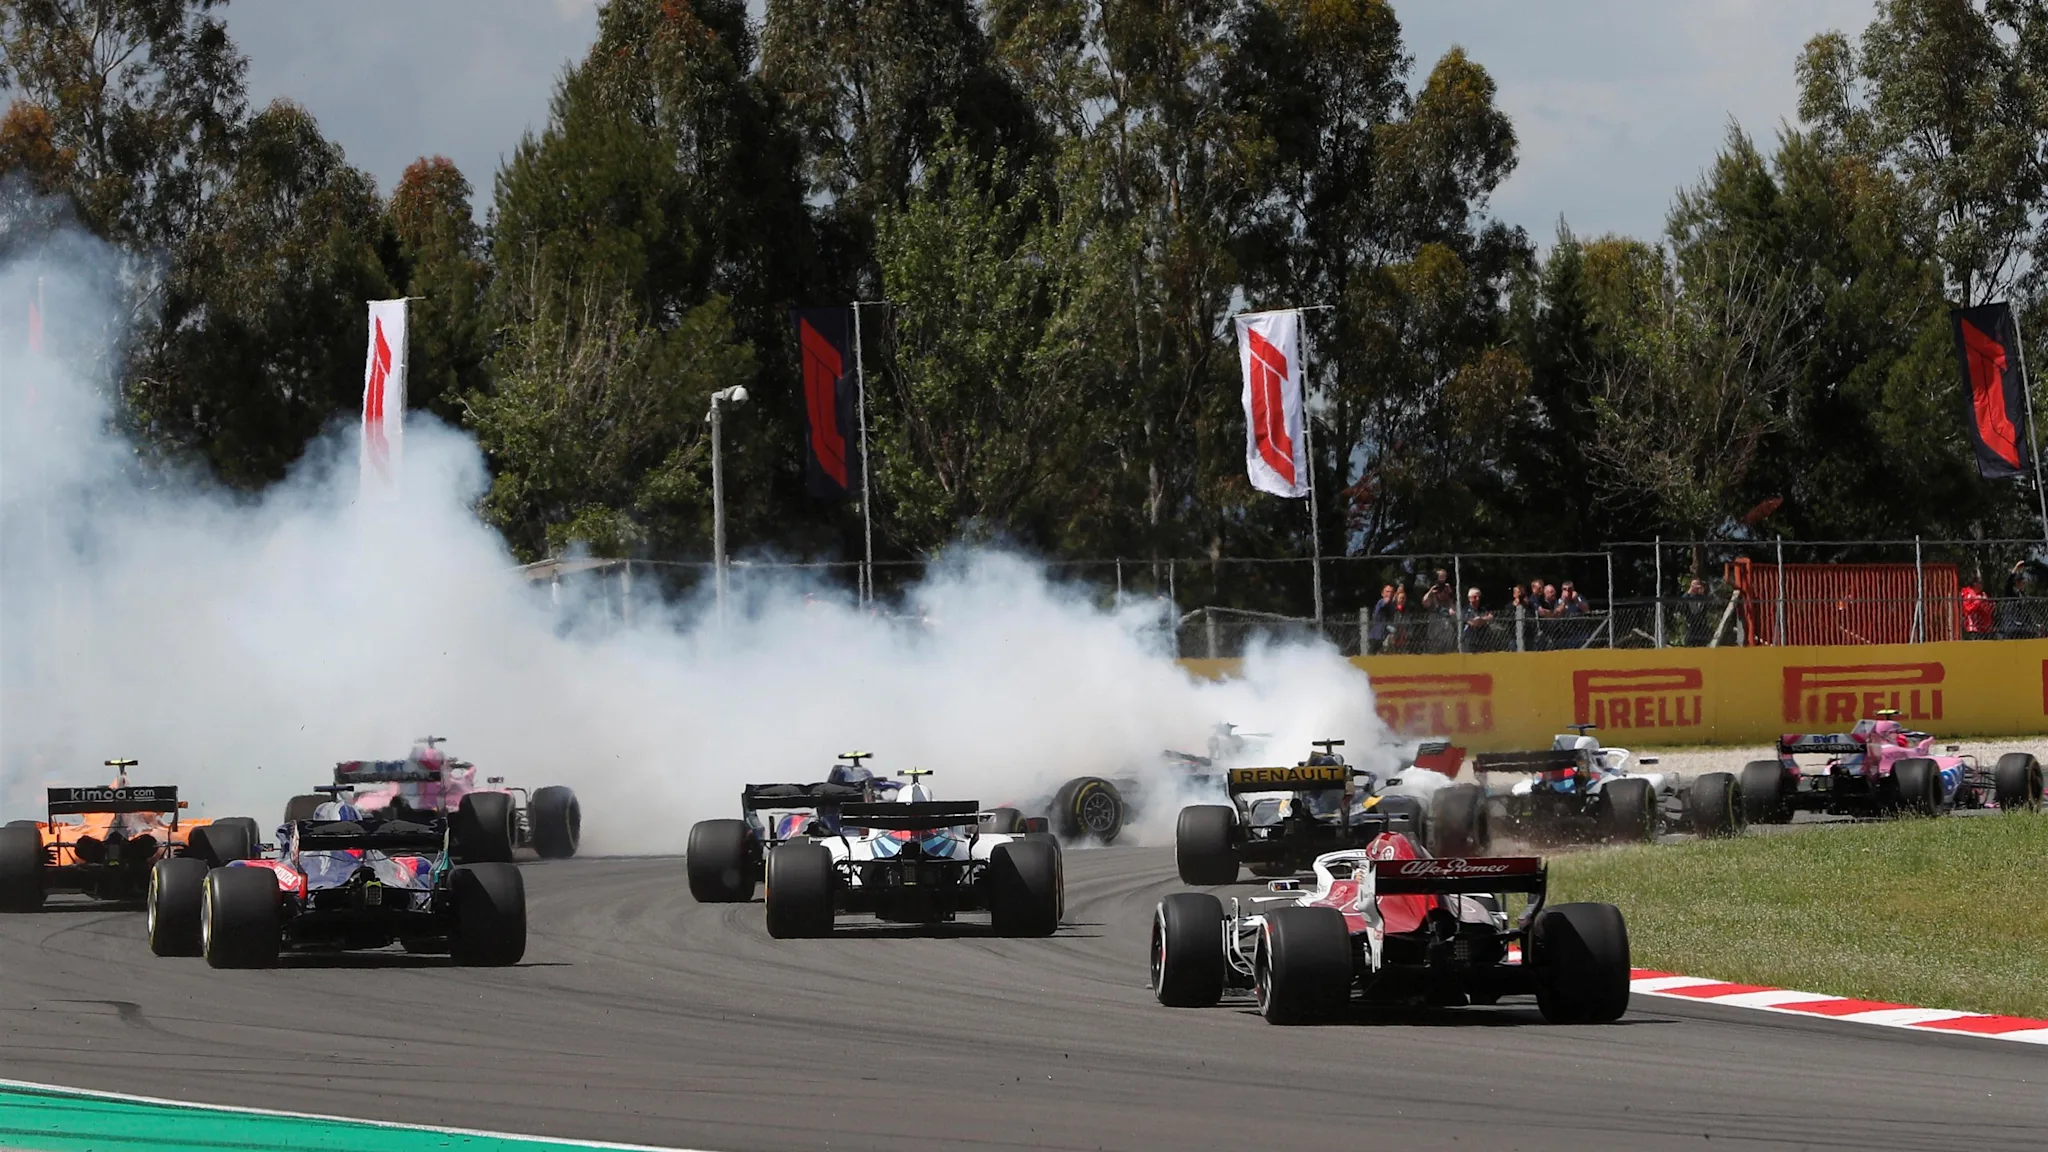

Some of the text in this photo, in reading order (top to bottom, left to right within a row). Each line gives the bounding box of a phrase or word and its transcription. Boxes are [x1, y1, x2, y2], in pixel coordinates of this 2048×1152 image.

[1573, 668, 1702, 729] PIRELLI
[1783, 662, 1945, 724] PIRELLI
[1240, 768, 1338, 782] RENAULT
[70, 788, 155, 800] kimoa.com
[1400, 858, 1509, 876] Alfa Romeo
